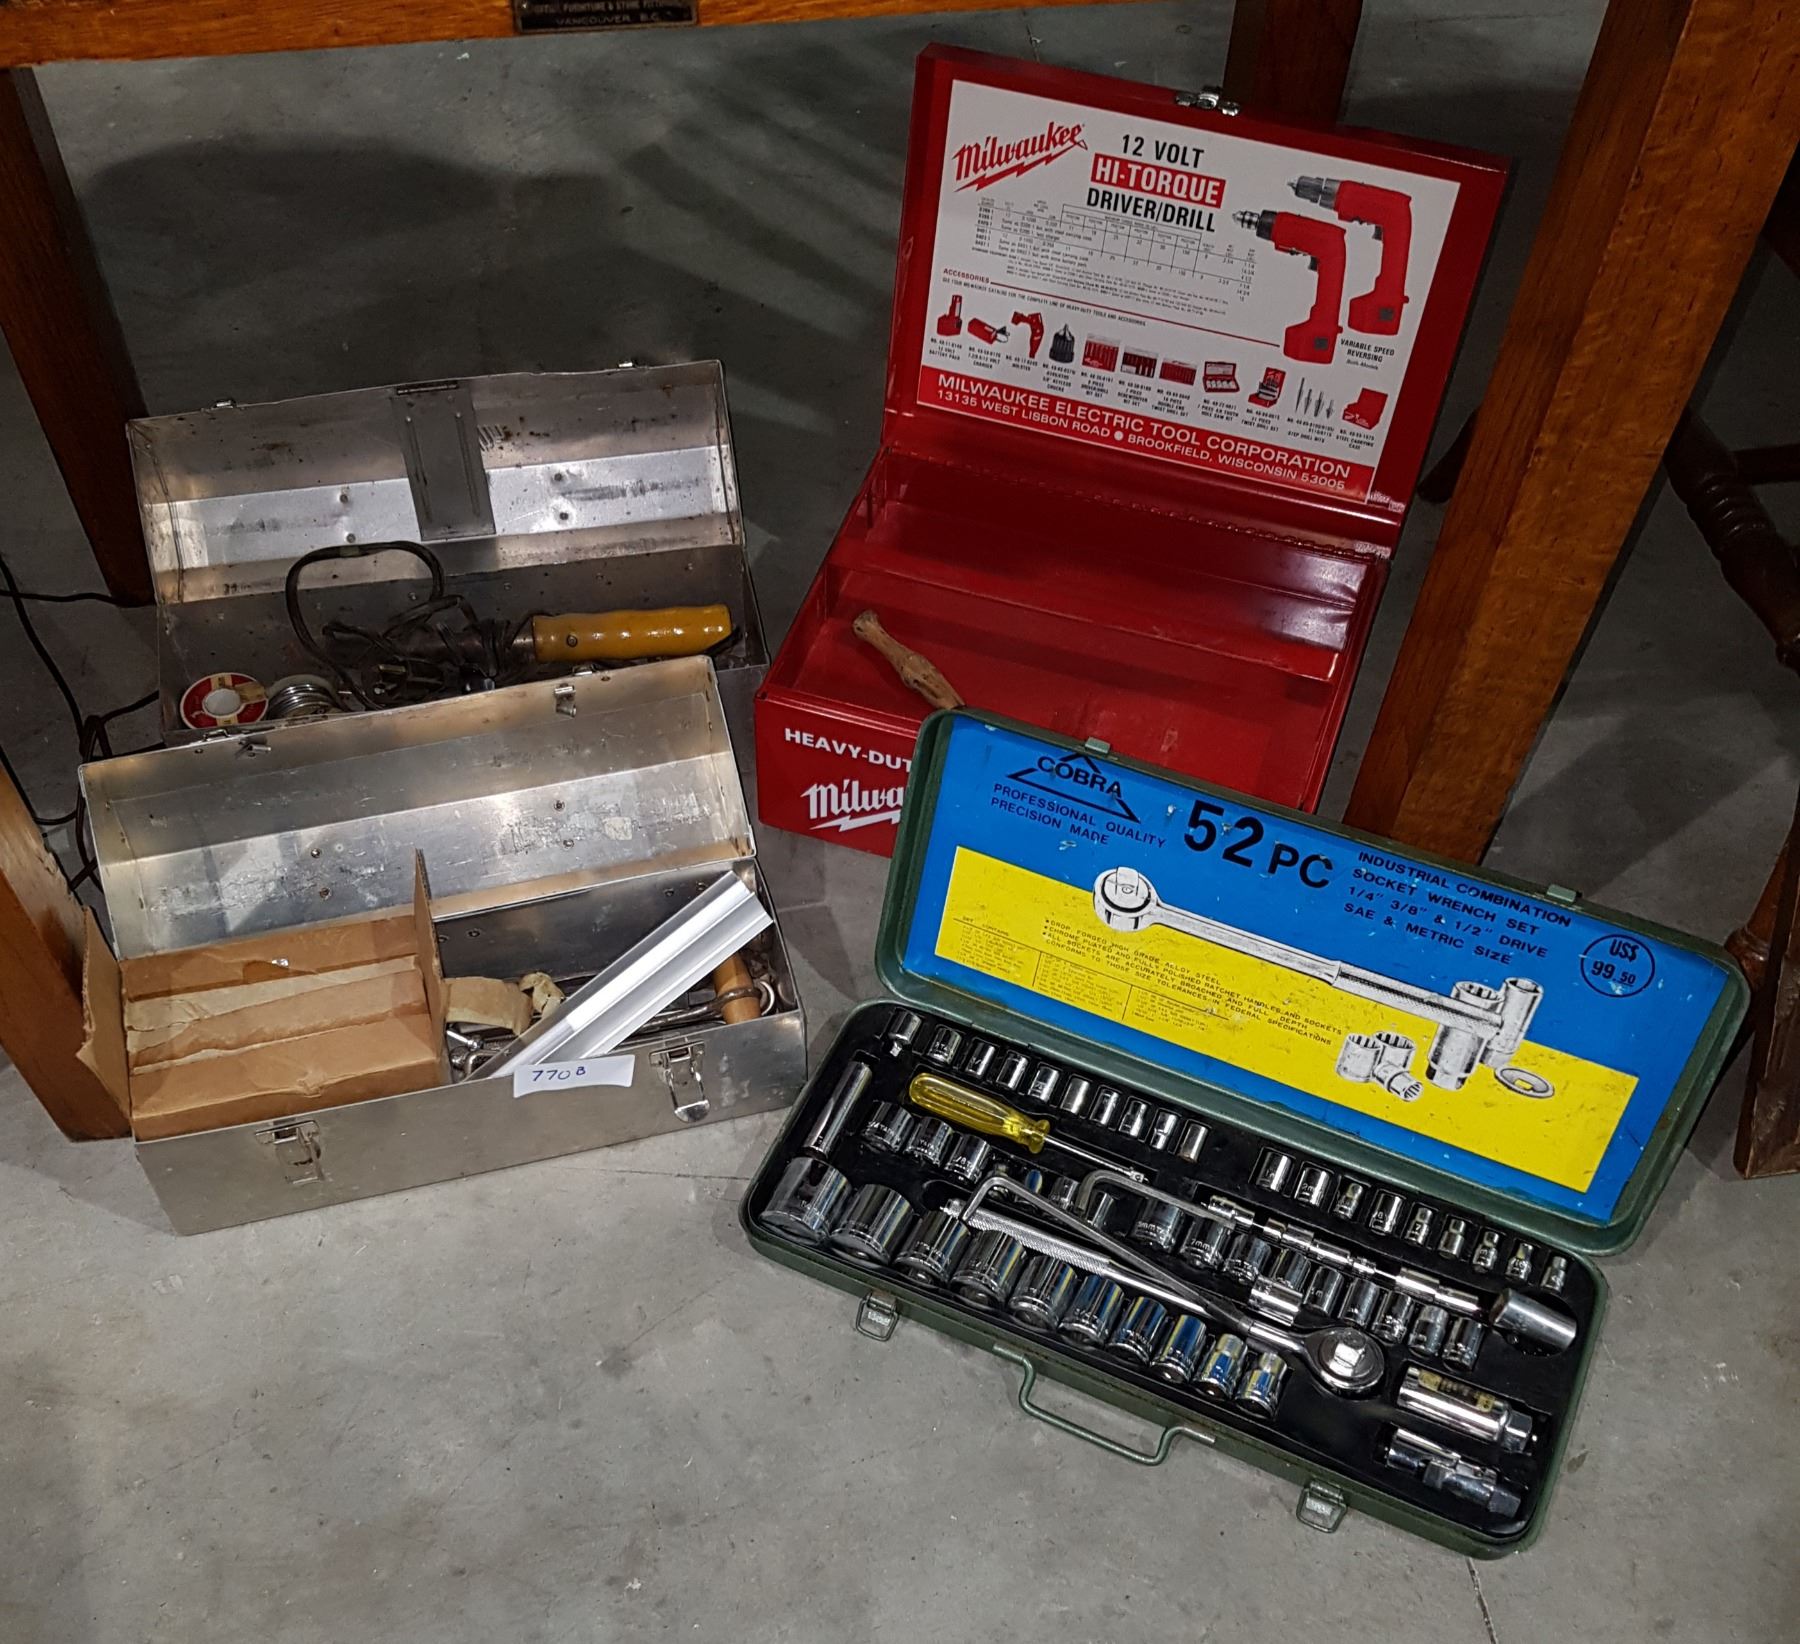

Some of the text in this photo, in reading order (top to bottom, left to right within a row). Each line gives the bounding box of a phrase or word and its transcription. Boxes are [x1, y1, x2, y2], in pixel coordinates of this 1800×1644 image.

[556, 15, 632, 26] VANCOUVER
[952, 121, 1082, 181] Milwaukee
[1121, 133, 1203, 168] 12 VOLT
[1096, 158, 1219, 204] HI-TORQUE
[1086, 188, 1217, 232] DRIVER/DRILL
[944, 268, 989, 283] ACCESSORIES
[1340, 338, 1394, 356] VARIABLE SPEED
[1347, 349, 1382, 362] REVERSING
[937, 389, 1345, 490] 13135 WEST LISBON ROAD BROOKFIELD, WISCONSIN 53005
[938, 374, 1350, 479] MILWAUKEE ELECTRIC TOOL CORPORATION
[785, 728, 913, 773] HEAVY-DUT
[800, 778, 904, 820] Milwa
[1037, 756, 1122, 798] COBRA
[990, 797, 1108, 844] PRECISION MADE
[993, 783, 1165, 848] PROFESSIONAL QUALITY
[1184, 800, 1333, 889] 52 PC
[1352, 867, 1538, 936] SOCKET WRENCH SET
[1358, 850, 1570, 927] INDUSTRIAL COMBINATION
[1050, 920, 1220, 985] DROP FORGED HIGH GRADE ALLOY STEEL
[1343, 902, 1511, 965] SAE & METRIC SIZE
[1433, 912, 1446, 925] &
[1498, 934, 1547, 958] DRIVE
[1609, 938, 1641, 963] US$
[1046, 939, 1085, 956] CONFORMS
[1106, 961, 1128, 972] THOSE
[1135, 971, 1150, 980] SIZE
[1157, 979, 1206, 1000] TOLERANCES
[1225, 1003, 1261, 1019] FEDERAL
[1267, 1018, 1331, 1044] SPECIFICATIONS
[1047, 933, 1306, 1029] ALL SOCKETS ARE ACCURATELY BROACHED AND FULL DEPTH
[1049, 927, 1078, 941] CHROME
[1083, 939, 1111, 953] PLATED
[1116, 951, 1130, 959] AND
[1134, 957, 1158, 969] FULLY
[1163, 968, 1200, 984] POLISHED
[1204, 982, 1239, 998] RATCHET
[1284, 1010, 1300, 1020] AND
[1304, 1018, 1341, 1034] SOCKETS
[532, 1069, 571, 1082] 770
